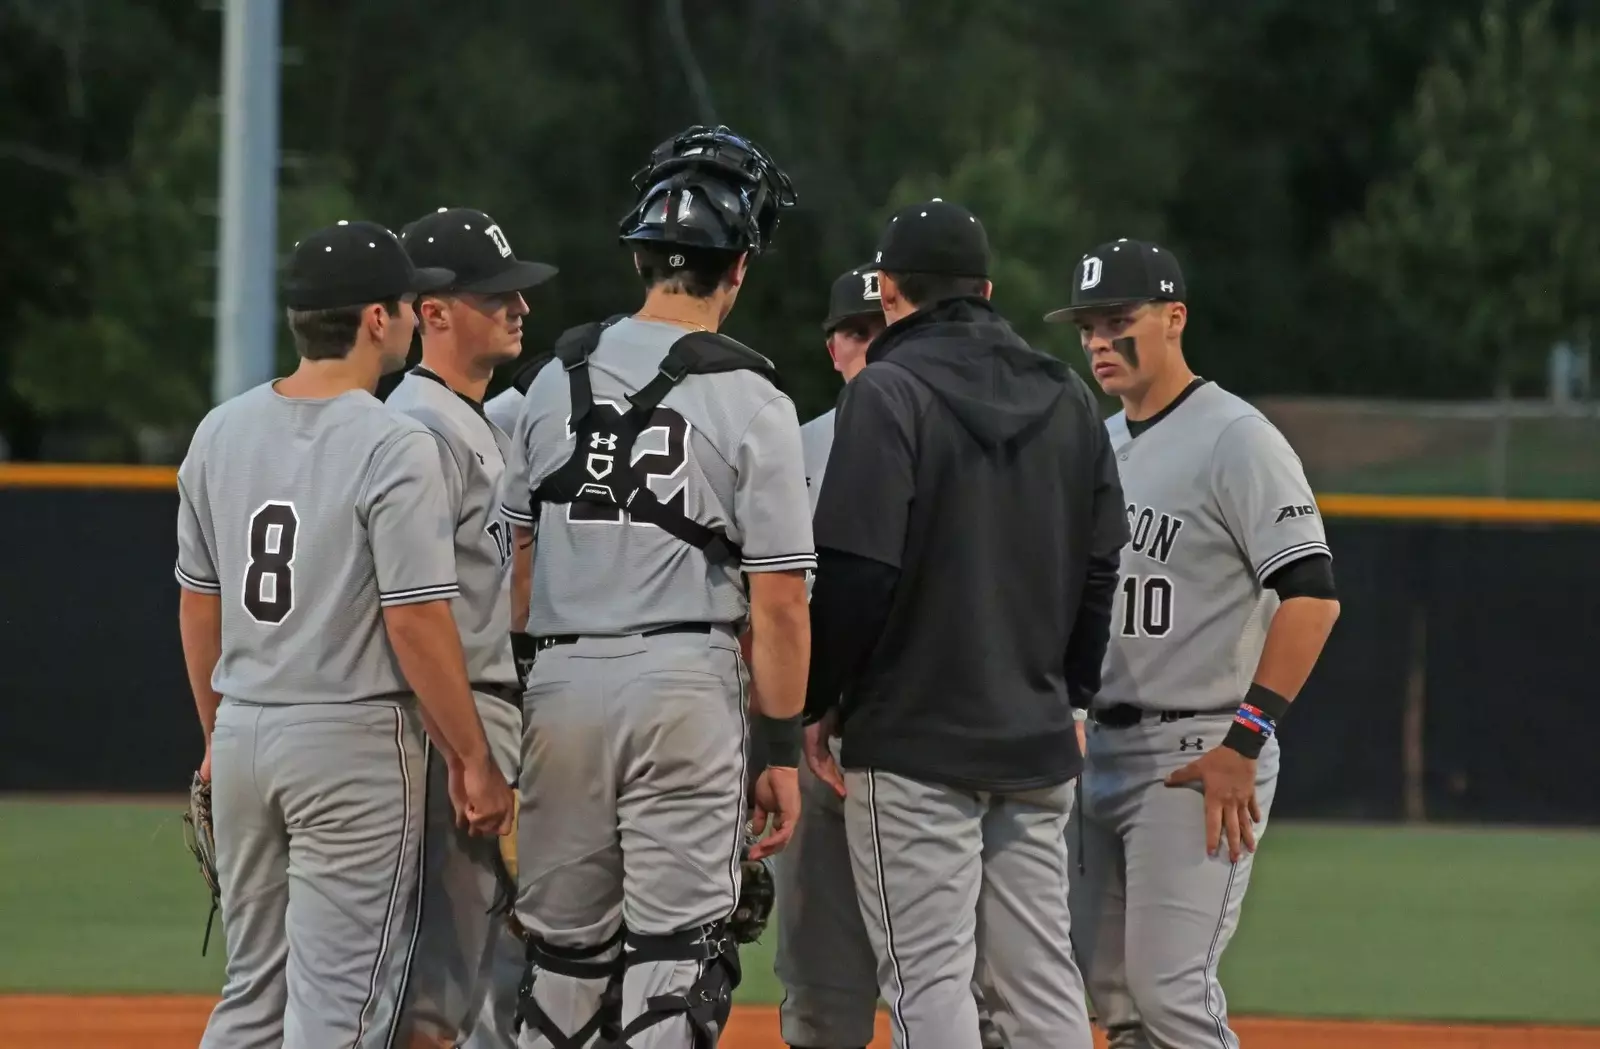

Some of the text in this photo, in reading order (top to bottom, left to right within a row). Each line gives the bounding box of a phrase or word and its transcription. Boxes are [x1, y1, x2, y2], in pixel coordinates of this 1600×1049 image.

[484, 224, 512, 258] D
[1080, 256, 1103, 290] D
[1274, 504, 1315, 525] A10
[241, 499, 301, 626] 8
[1120, 574, 1174, 638] 10
